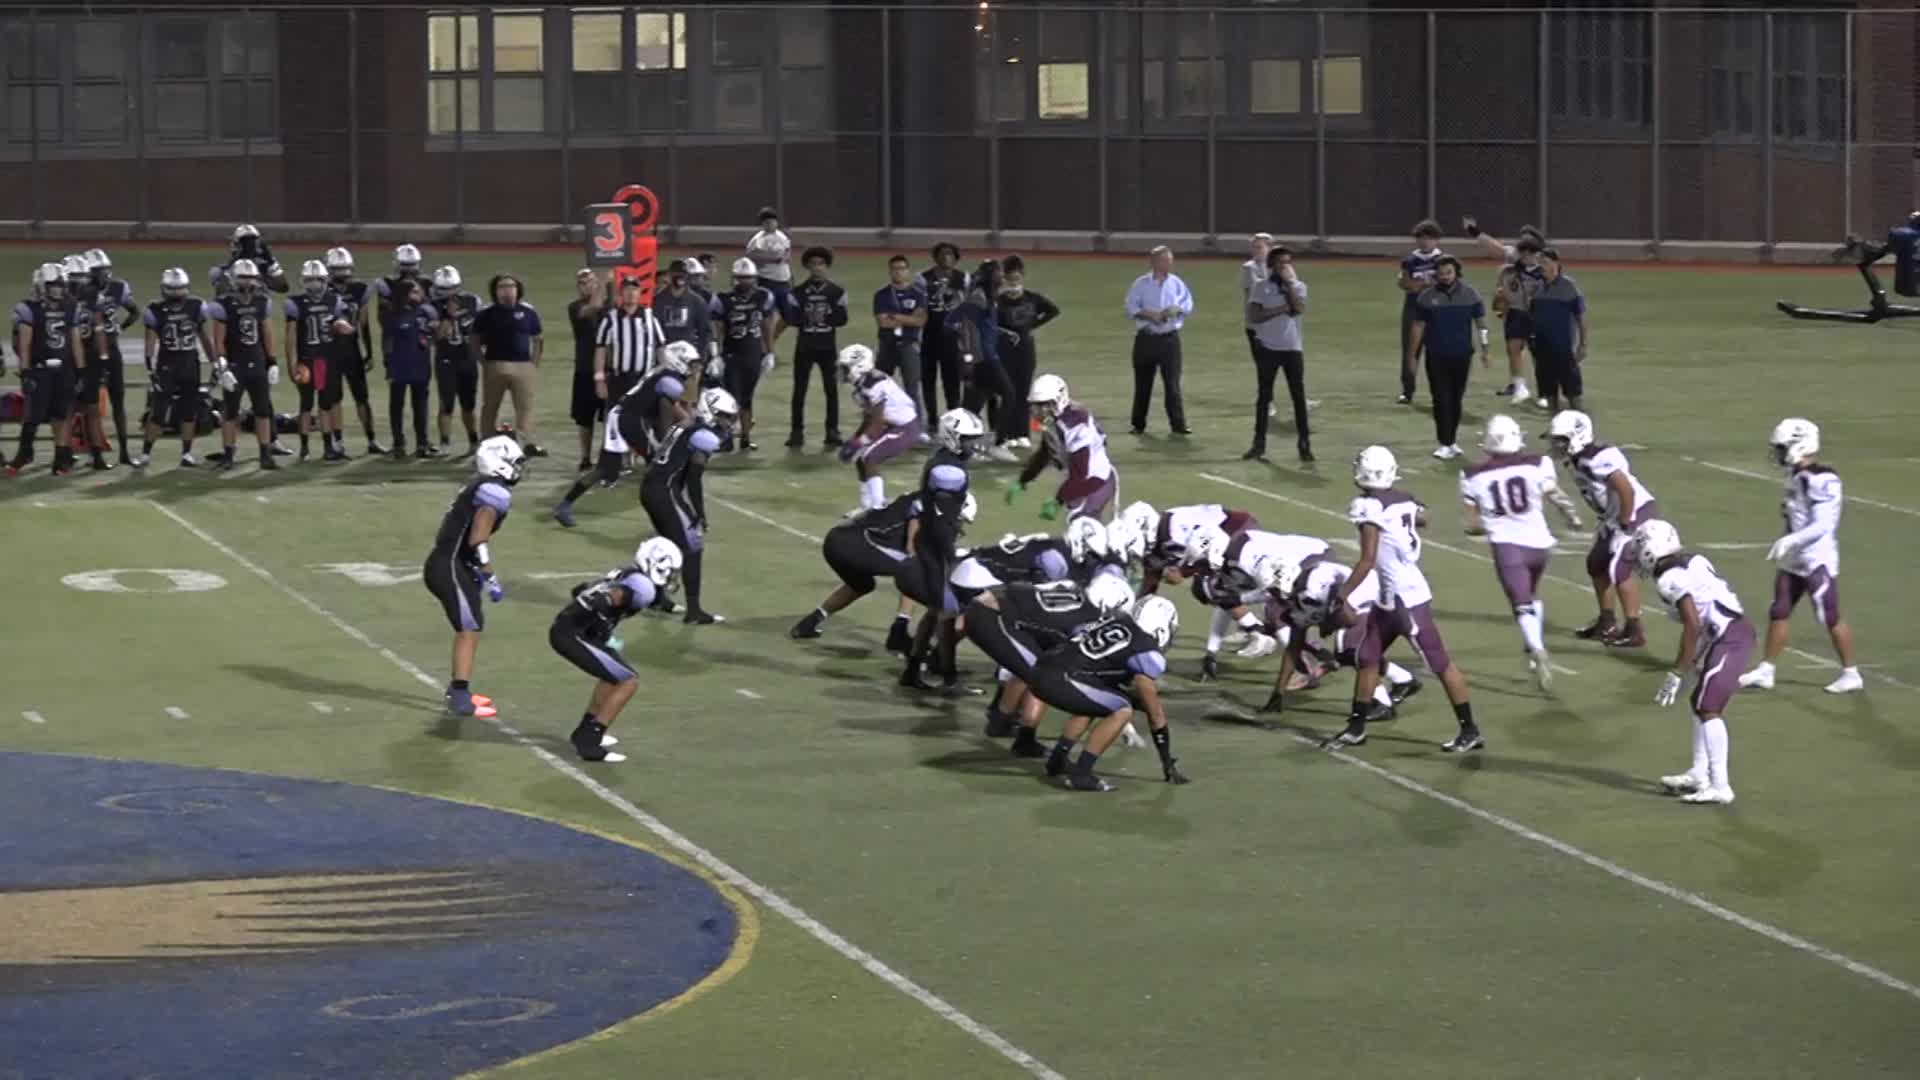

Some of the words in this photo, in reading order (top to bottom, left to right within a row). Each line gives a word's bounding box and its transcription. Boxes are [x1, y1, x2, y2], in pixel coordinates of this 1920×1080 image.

[593, 212, 625, 252] 3
[46, 319, 66, 349] 5
[1487, 475, 1532, 517] 10
